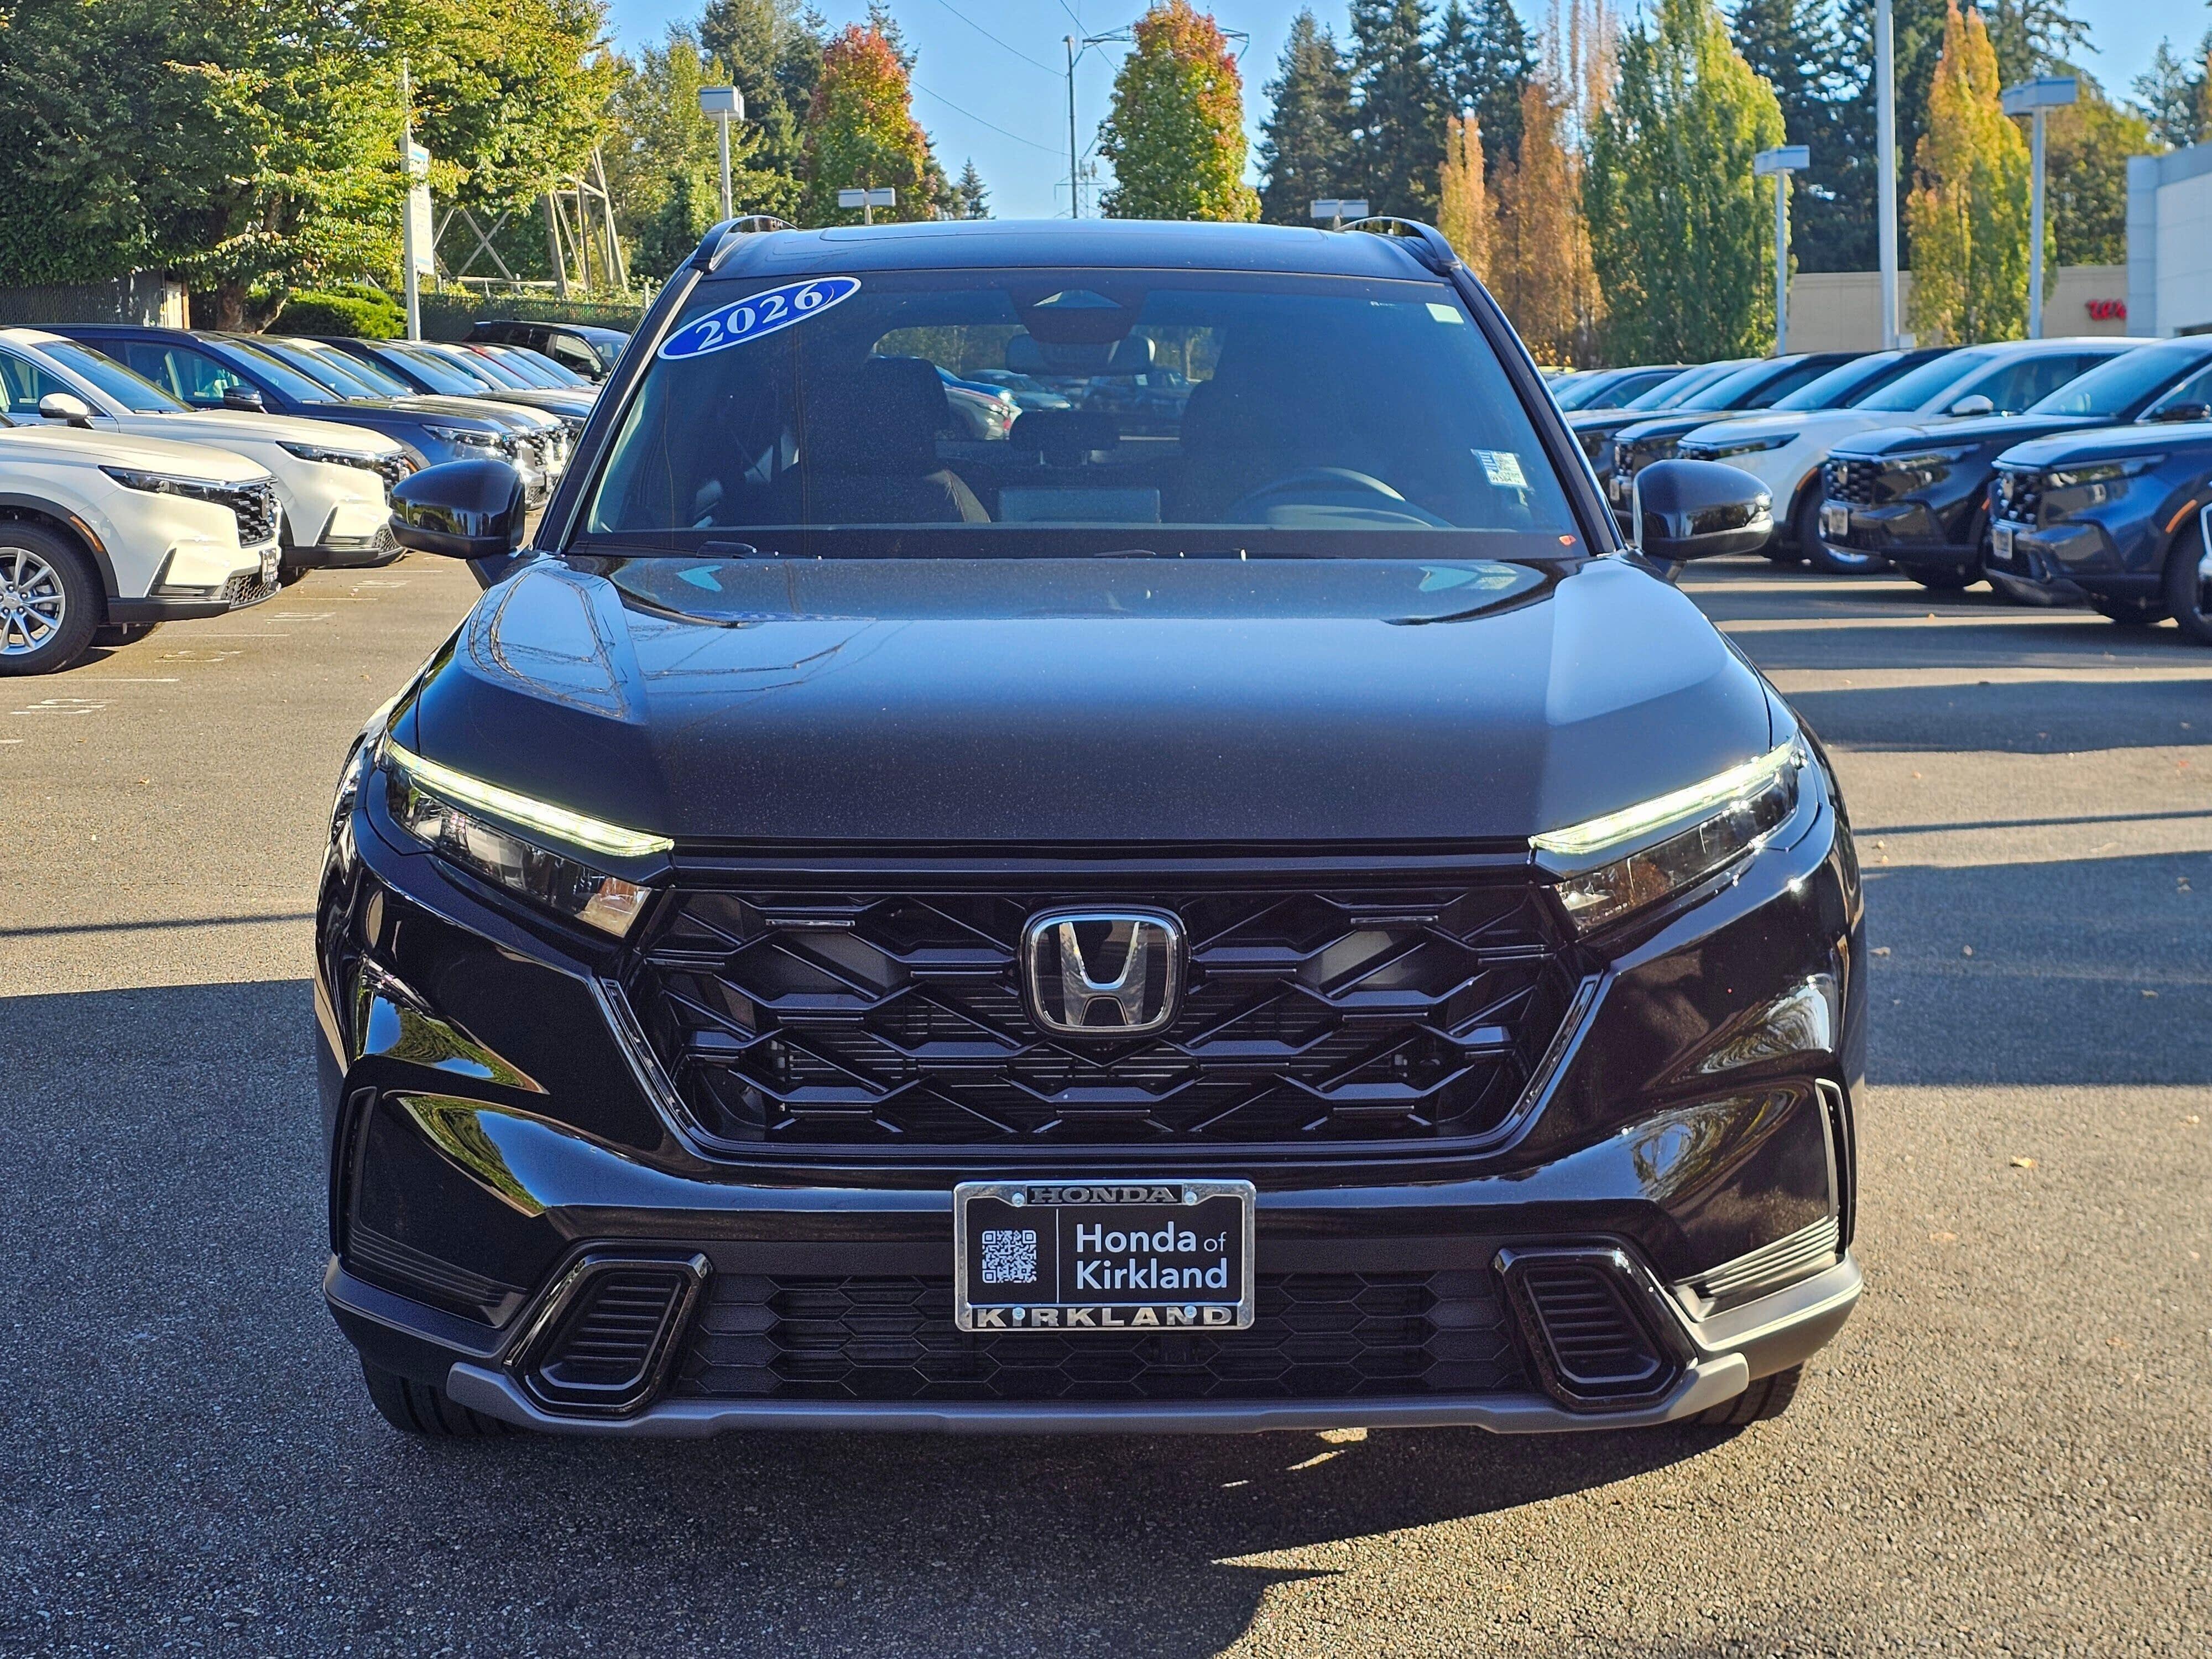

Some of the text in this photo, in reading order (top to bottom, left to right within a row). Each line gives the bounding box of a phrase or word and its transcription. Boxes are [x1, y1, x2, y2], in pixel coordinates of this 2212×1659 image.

[695, 283, 823, 351] 2026
[1031, 1187, 1178, 1203] HONDA
[1076, 1221, 1227, 1253] Honda of
[1076, 1258, 1228, 1290] Kirkland
